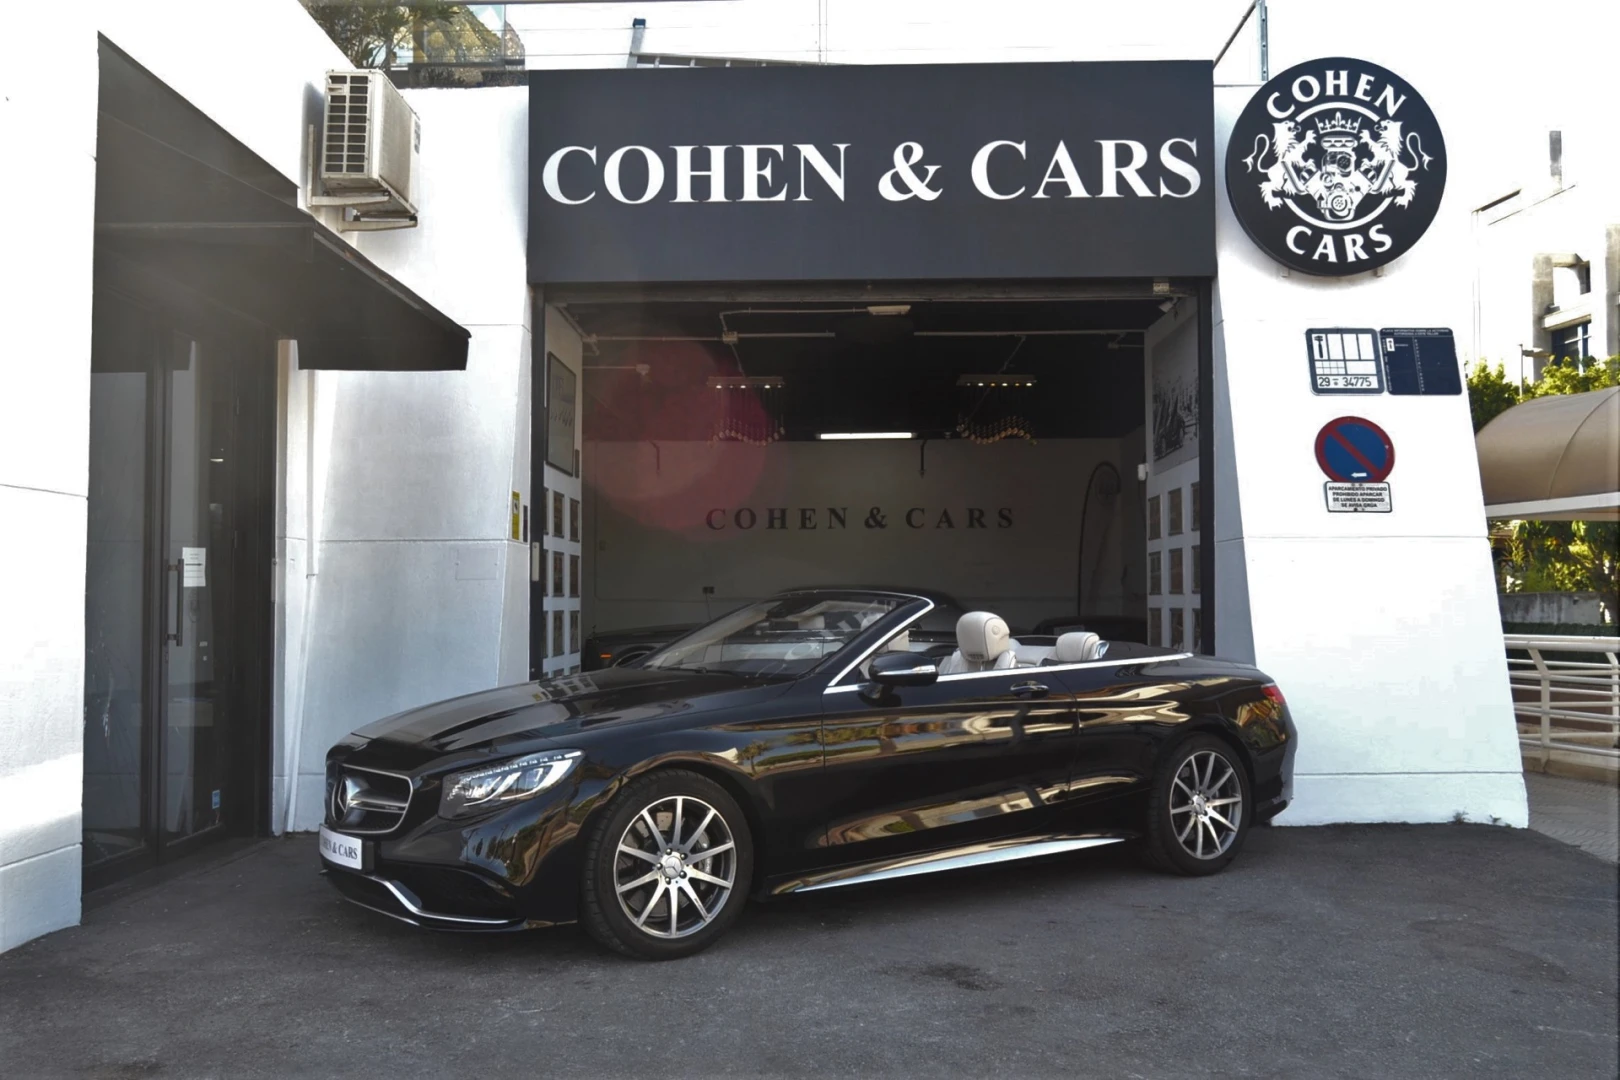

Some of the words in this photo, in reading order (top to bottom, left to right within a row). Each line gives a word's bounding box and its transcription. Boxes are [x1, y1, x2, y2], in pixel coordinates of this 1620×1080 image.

[1266, 70, 1407, 118] COHEN
[542, 143, 851, 204] COHEN
[878, 141, 943, 201] &
[971, 138, 1201, 200] CARS
[1286, 223, 1392, 262] CARS
[1318, 376, 1331, 387] 29
[1342, 376, 1372, 387] 34775
[705, 507, 848, 530] COHEN
[864, 506, 888, 529] &
[905, 507, 1013, 529] CARS
[332, 841, 337, 854] &
[338, 843, 358, 860] CARS
